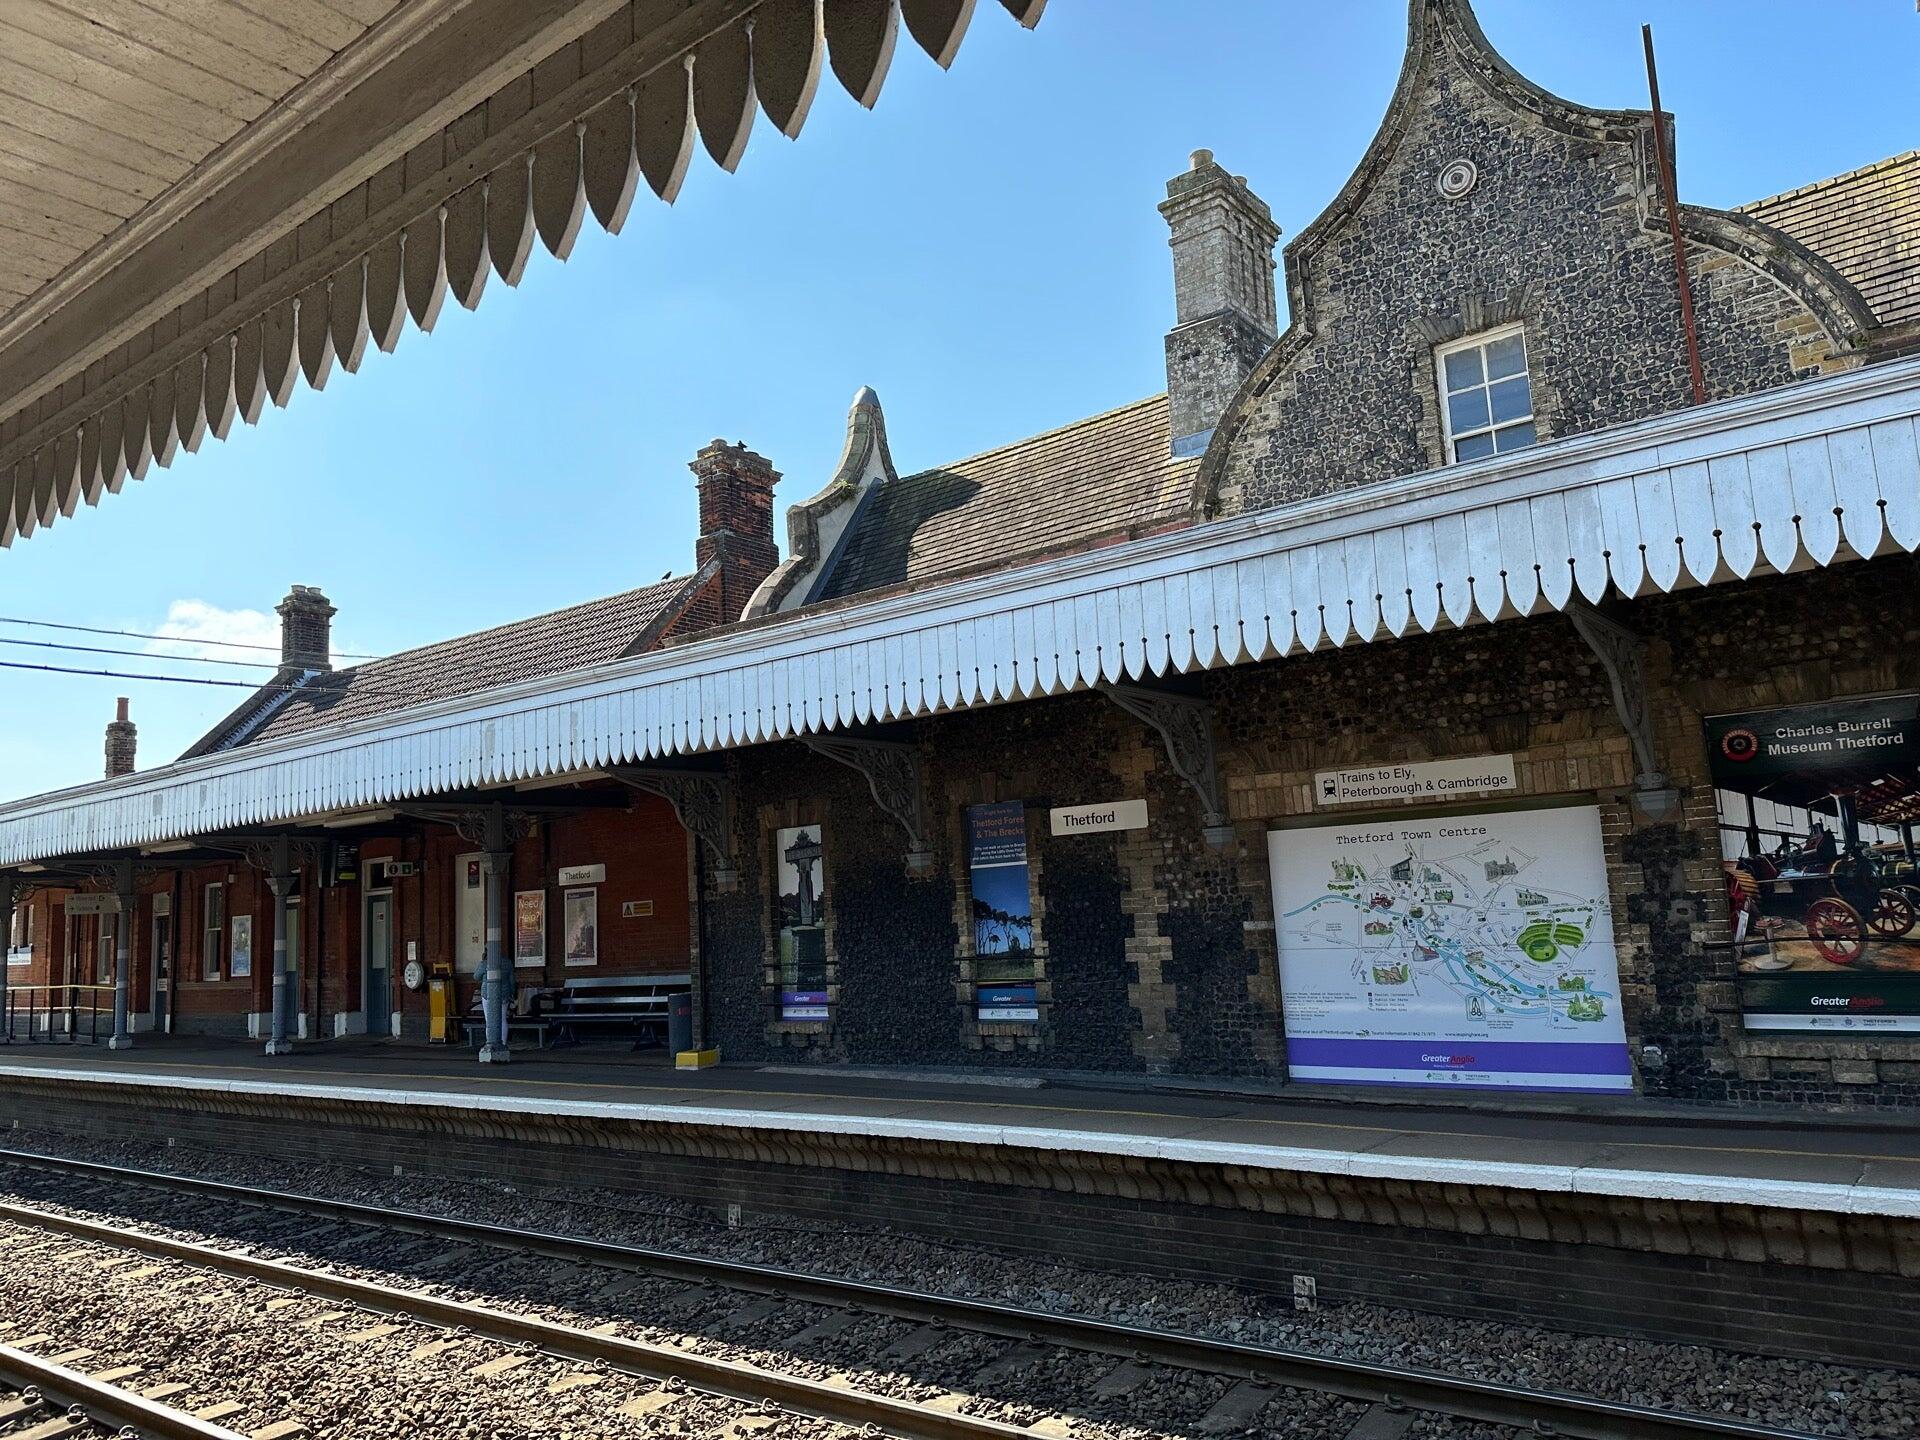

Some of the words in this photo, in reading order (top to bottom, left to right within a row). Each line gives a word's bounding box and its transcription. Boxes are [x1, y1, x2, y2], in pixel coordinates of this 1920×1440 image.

[1775, 725, 1834, 739] Charles
[1837, 718, 1891, 733] Burrell
[1768, 740, 1832, 756] Museum
[1836, 733, 1904, 749] Thetford
[1340, 771, 1375, 784] Trains
[1378, 770, 1390, 780] to
[1393, 767, 1415, 779] Ely,
[1342, 782, 1422, 798] Peterborough
[1425, 780, 1434, 791] &
[1438, 774, 1508, 790] Cambridge
[971, 817, 1002, 828] Thetford
[1063, 811, 1115, 827] Thetford
[976, 830, 982, 839] &
[984, 829, 998, 838] The
[1335, 832, 1394, 845] Thetford
[1401, 830, 1432, 840] Town
[1439, 826, 1487, 838] Centre
[564, 871, 591, 881] Thetford
[518, 899, 539, 909] Need
[518, 911, 540, 922] Help?
[1810, 996, 1850, 1006] Greater
[1421, 1054, 1450, 1063] Greater
[1450, 1055, 1475, 1064] Anglia
